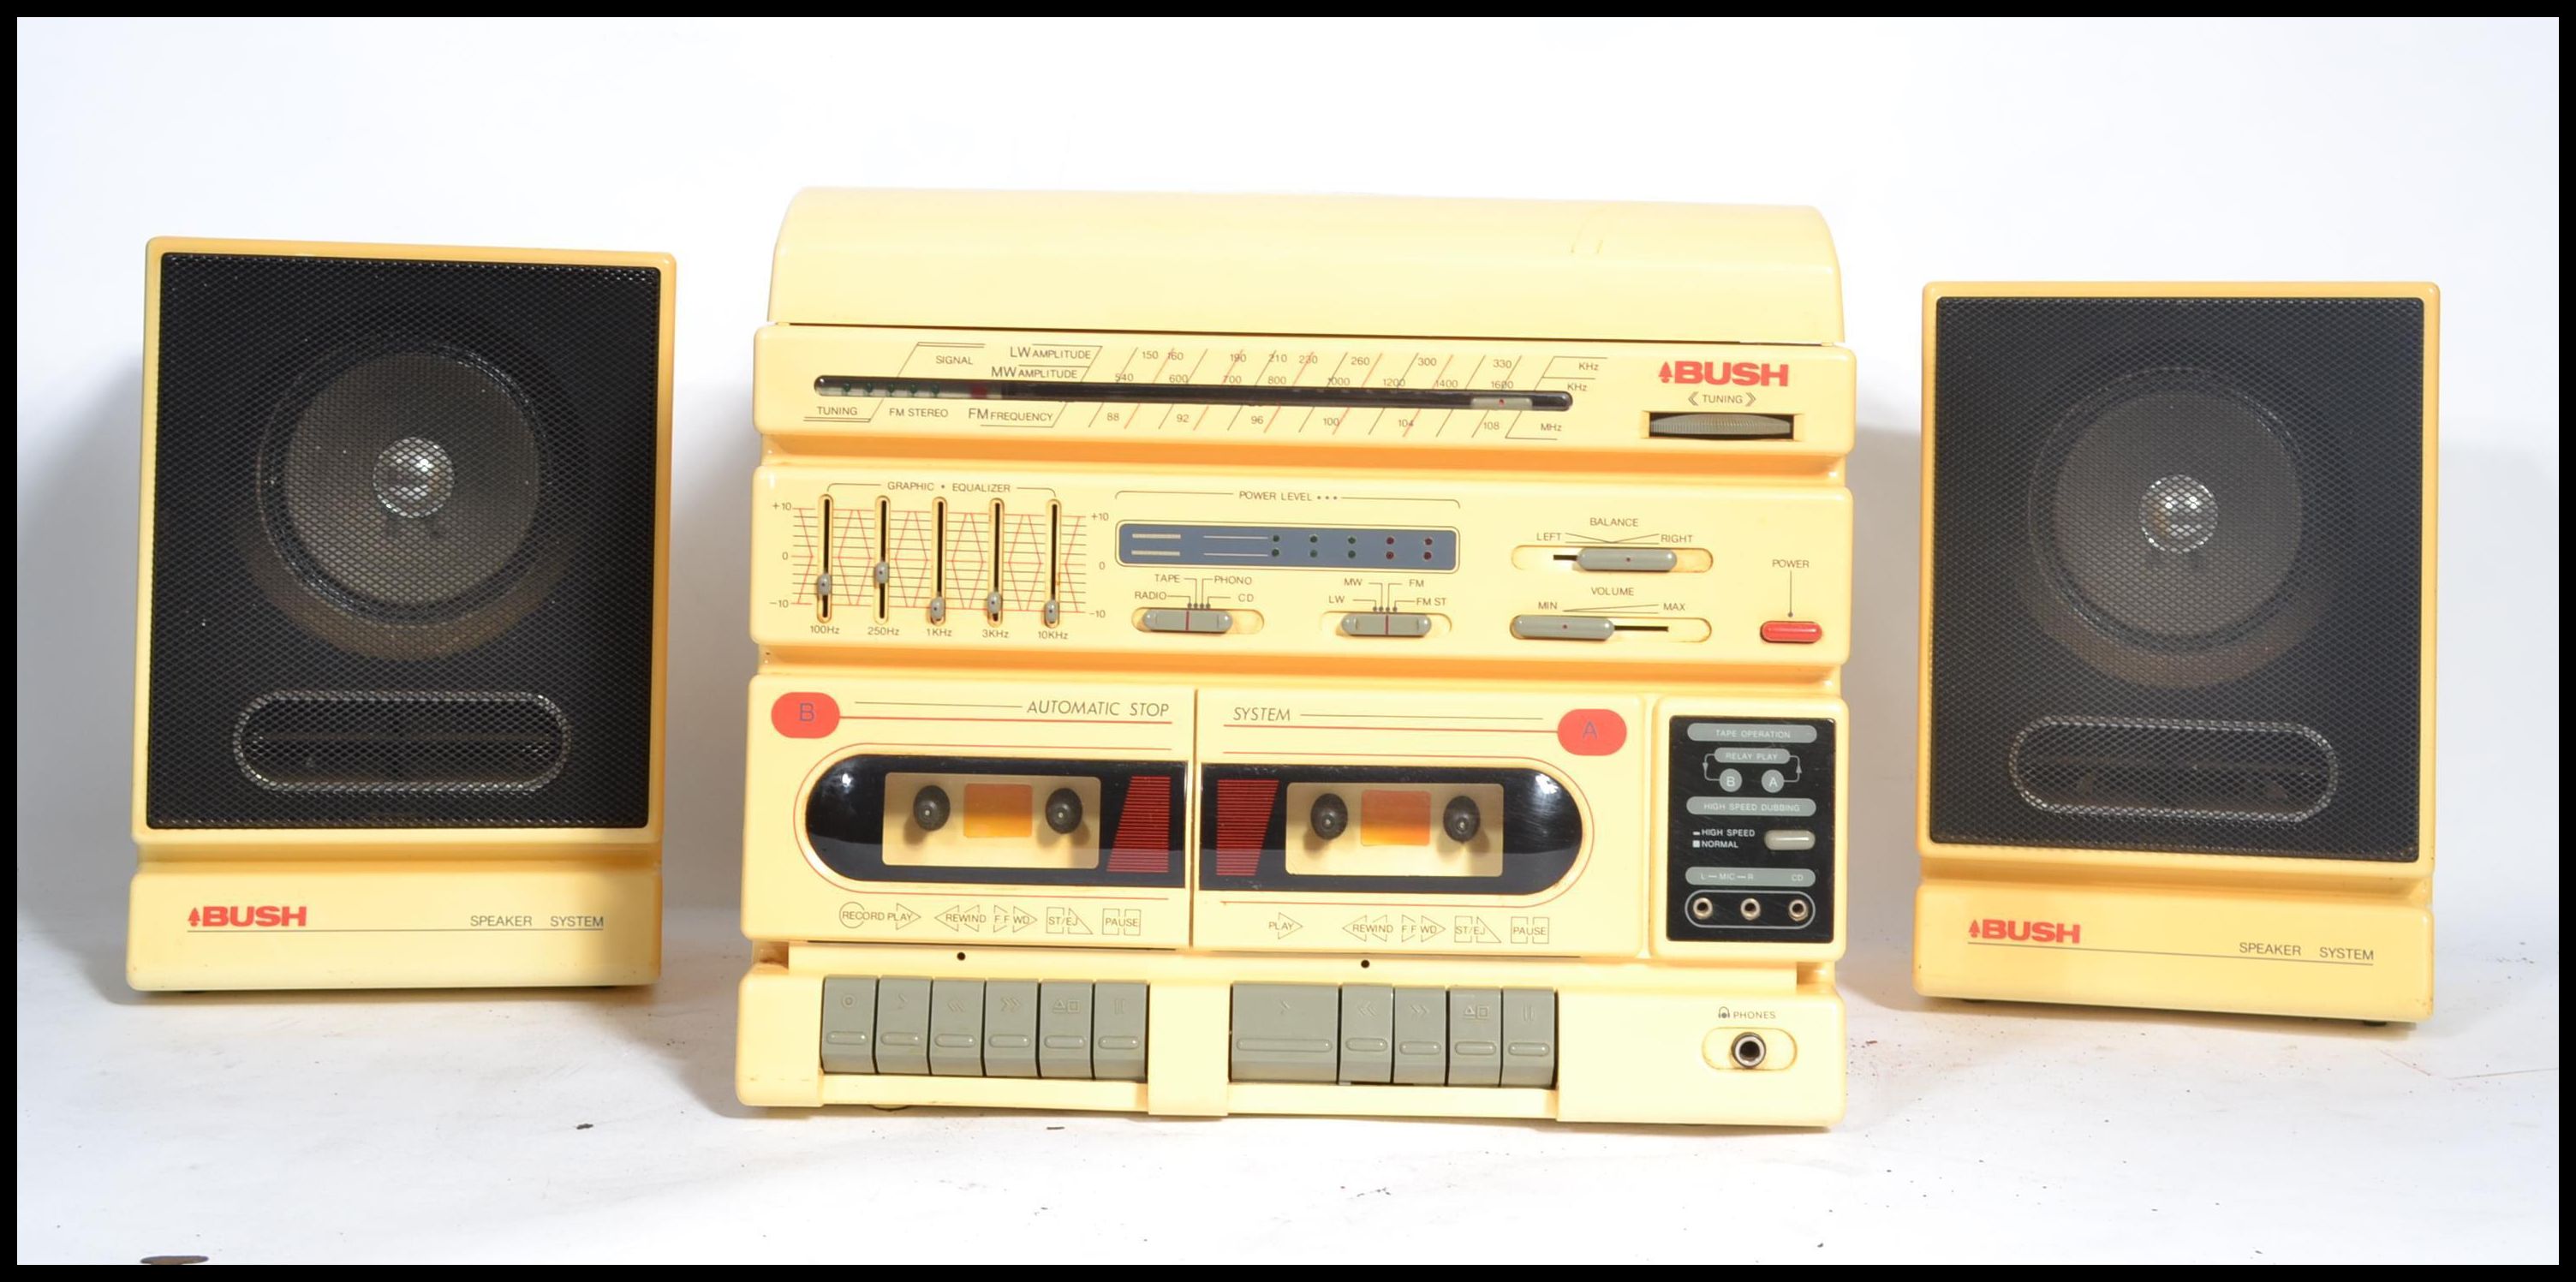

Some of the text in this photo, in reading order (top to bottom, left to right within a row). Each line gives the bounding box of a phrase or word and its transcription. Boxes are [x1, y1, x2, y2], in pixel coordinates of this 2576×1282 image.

[1010, 345, 1091, 360] LW AMPLITUDE
[1142, 350, 1158, 360] 150
[1167, 351, 1184, 361] 160
[935, 355, 973, 366] SIGNAL
[1230, 354, 1246, 363] 190
[1268, 354, 1287, 363] 210
[1351, 356, 1370, 366] 260
[1418, 357, 1437, 367] 300
[1493, 359, 1512, 369] 330
[1579, 361, 1599, 372] KHz
[992, 366, 1077, 379] MW AMPLITUDE
[1115, 373, 1134, 382] 540
[1673, 361, 1789, 387] BUSH
[1169, 374, 1189, 384] 600
[1224, 375, 1242, 385] 700
[1268, 375, 1286, 385] 800
[1327, 377, 1350, 386] 1000
[1383, 379, 1406, 388] 1200
[1435, 379, 1458, 389] 1400
[1490, 380, 1514, 390] 1600
[1567, 382, 1588, 392] KHz
[1702, 395, 1743, 405] TUNING
[816, 406, 857, 416] TUNING
[889, 408, 948, 419] FM STEREO
[968, 408, 1053, 422] FM FREQUENCY
[1106, 413, 1119, 422] 88
[1176, 414, 1190, 423] 92
[1250, 415, 1264, 425] 96
[1323, 417, 1340, 426] 100
[1398, 419, 1414, 428] 104
[1483, 421, 1500, 431] 108
[1541, 422, 1562, 432] MHz
[887, 481, 1011, 493] GRAPHIC EQUALIZER
[1239, 491, 1312, 501] POWER LEVEL
[1589, 516, 1639, 528] BALANCE
[1536, 532, 1561, 542] LEFT
[1661, 534, 1693, 544] RIGHT
[781, 552, 789, 561] 0
[1099, 562, 1106, 570] 0
[1772, 559, 1810, 569] POWER
[1154, 574, 1180, 584] TAPE
[1213, 575, 1252, 586] PHONO
[1344, 577, 1363, 587] MW
[1409, 579, 1424, 588] FM
[1135, 591, 1166, 600] RADIO
[1590, 587, 1635, 597] VOLUME
[1238, 593, 1254, 603] CD
[1328, 595, 1345, 604] LW
[1416, 597, 1446, 606] FM ST
[1538, 601, 1558, 611] MIN
[1663, 602, 1686, 611] MAX
[809, 624, 840, 635] 100Hz
[868, 626, 899, 636] 250Hz
[927, 627, 952, 637] 1KHz
[982, 629, 1009, 639] 3KHz
[1038, 629, 1069, 640] 10KHz
[799, 702, 815, 722] B
[1026, 700, 1169, 718] AUTOMATIC STOP
[1233, 707, 1291, 721] SYSTEM
[1581, 721, 1598, 740] A
[1715, 730, 1791, 739] TAPE OPERATION
[1726, 752, 1779, 761] RELAY PLAY
[1726, 776, 1736, 787] B
[1768, 777, 1778, 788] A
[1703, 802, 1800, 813] HIGH SPEED DUBBING
[1702, 828, 1756, 838] HIGH SPEED
[1702, 840, 1738, 849] NORMAL
[1792, 874, 1804, 882] CD
[202, 906, 307, 928] BUSH
[470, 915, 604, 927] SPEAKER SYSTEM
[843, 910, 913, 922] RECORD PLAY
[945, 913, 987, 924] REWIND
[1048, 916, 1078, 927] ST/EJ
[1105, 917, 1139, 927] PAUSE
[1268, 921, 1294, 931] PLAY
[1352, 924, 1393, 933] REWIND
[1455, 926, 1486, 935] ST/EJ
[1512, 926, 1547, 936] PAUSE
[1982, 919, 2081, 944] BUSH
[2239, 942, 2375, 961] SPEAKER SYSTEM
[1732, 1011, 1776, 1019] PHONES
